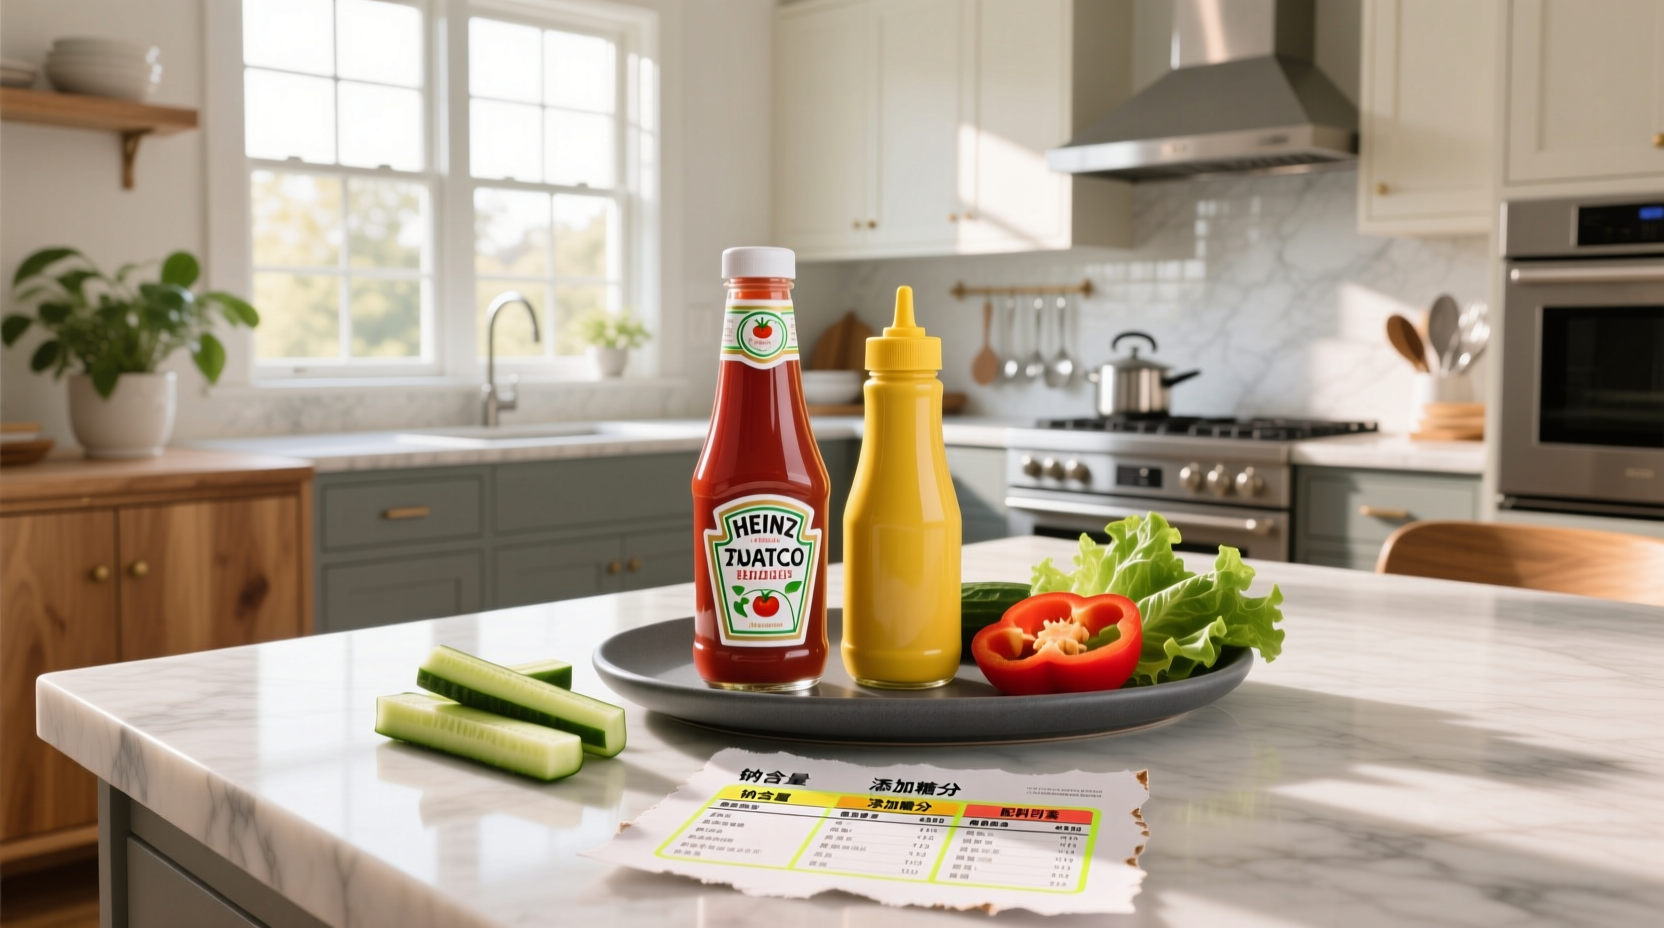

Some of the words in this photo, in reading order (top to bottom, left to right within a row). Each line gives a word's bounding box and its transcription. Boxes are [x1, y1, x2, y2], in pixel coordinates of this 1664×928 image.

[732, 514, 798, 539] HEINZ
[869, 777, 961, 797] 添加糖分
